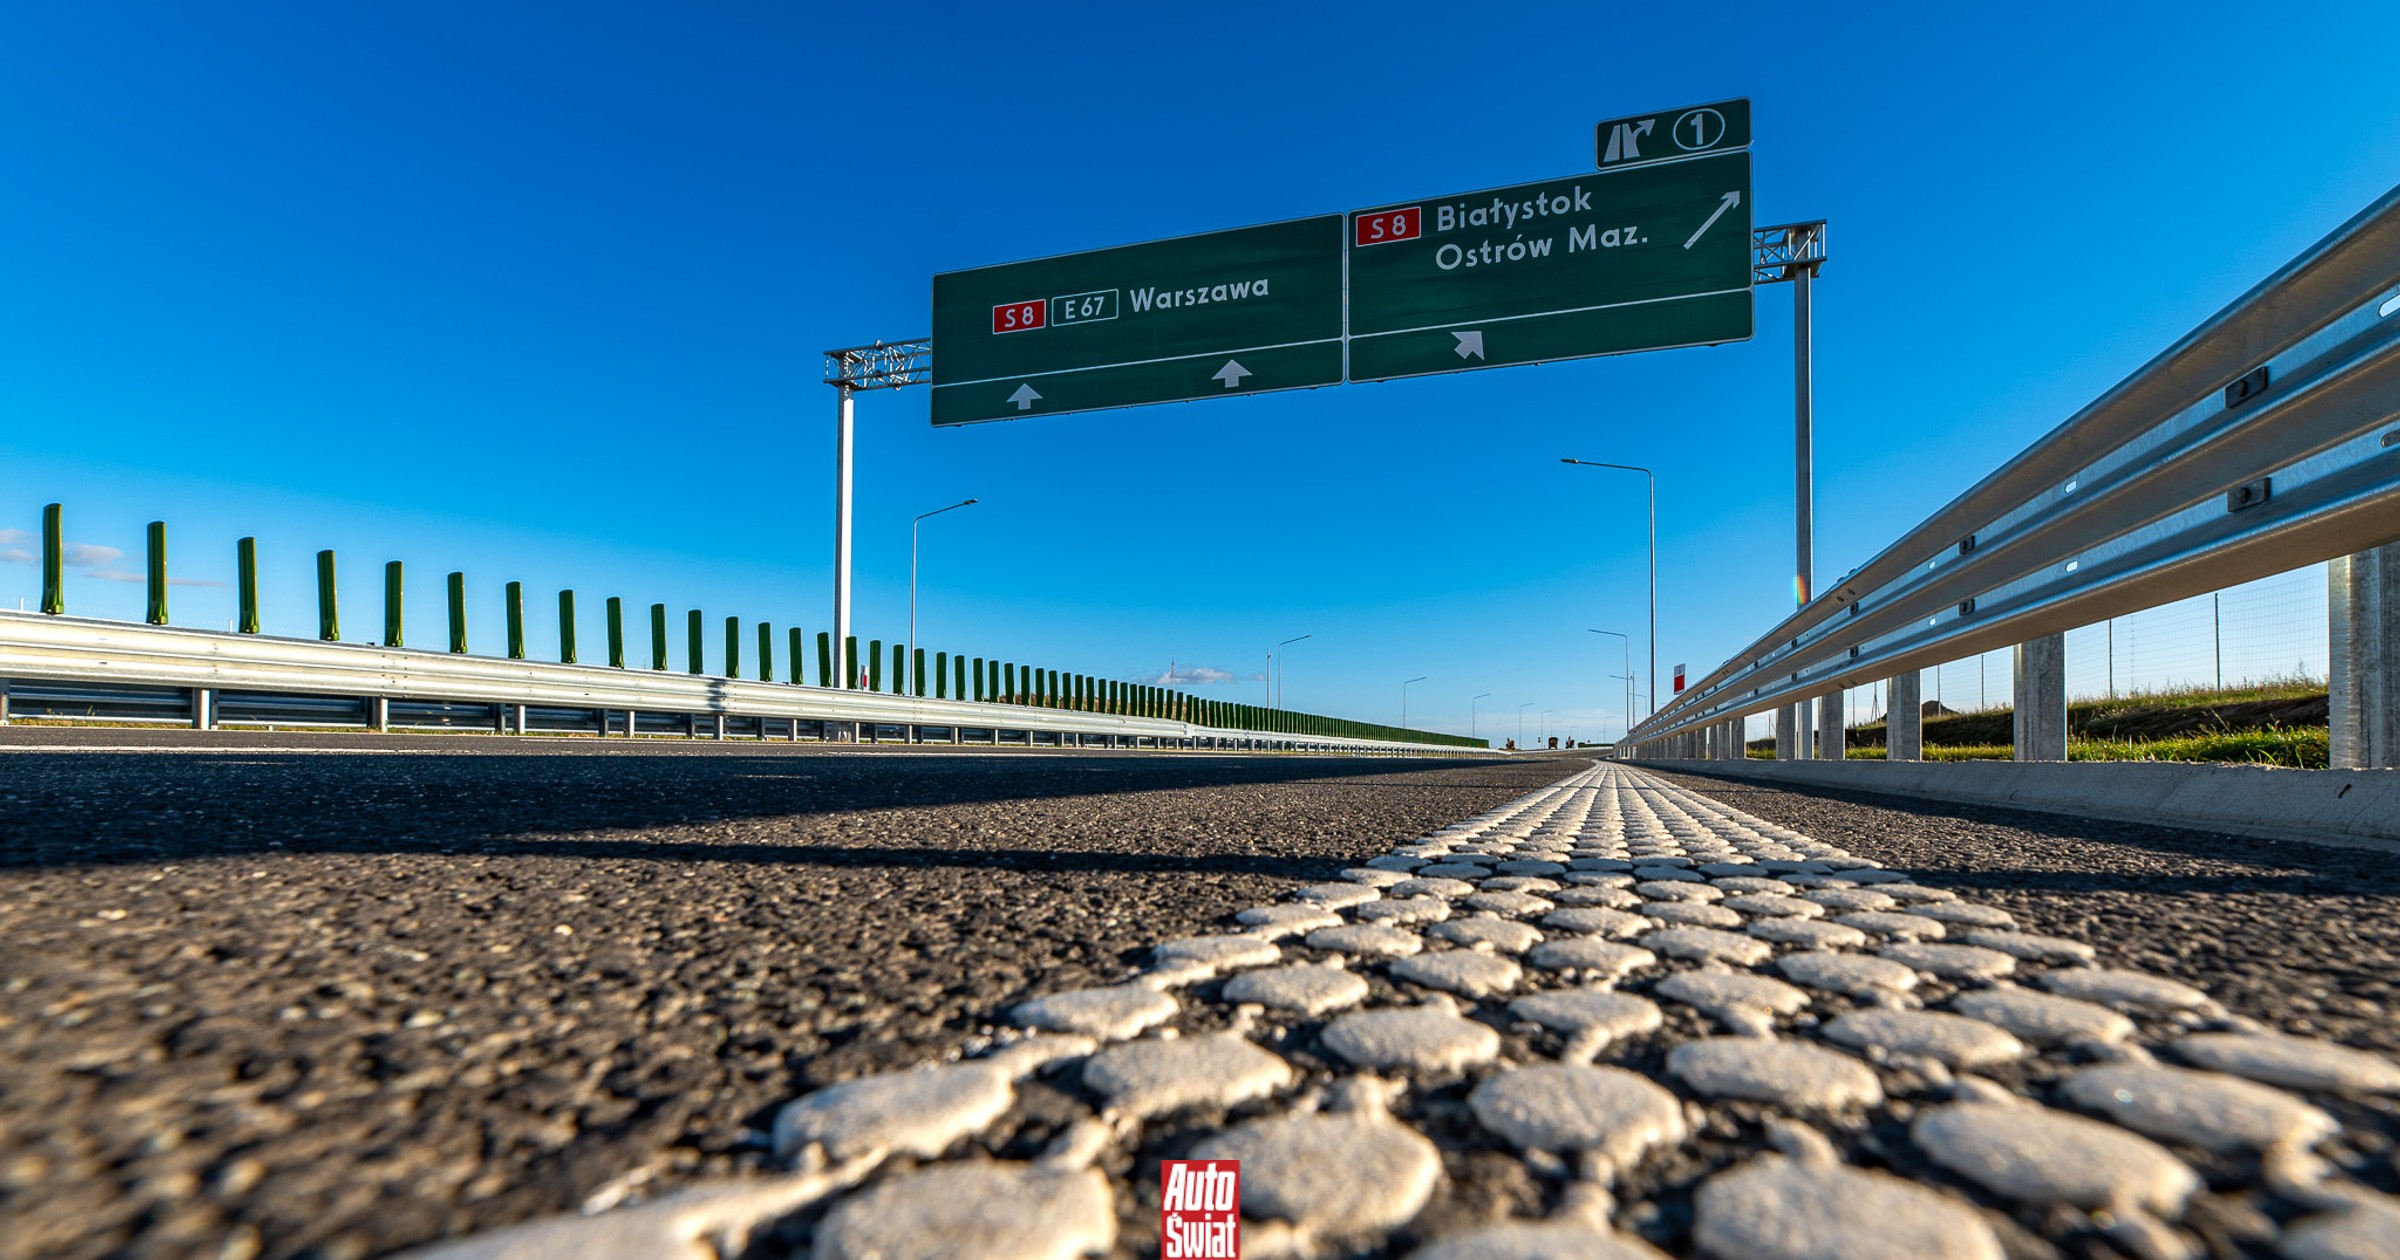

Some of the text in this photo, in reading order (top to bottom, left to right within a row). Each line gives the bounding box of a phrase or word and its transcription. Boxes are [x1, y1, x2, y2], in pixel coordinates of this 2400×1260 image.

[1690, 113, 1704, 146] 1
[1437, 186, 1592, 231] Białystok
[1435, 223, 1648, 270] Ostrów Maz.
[1129, 278, 1270, 313] Warszawa
